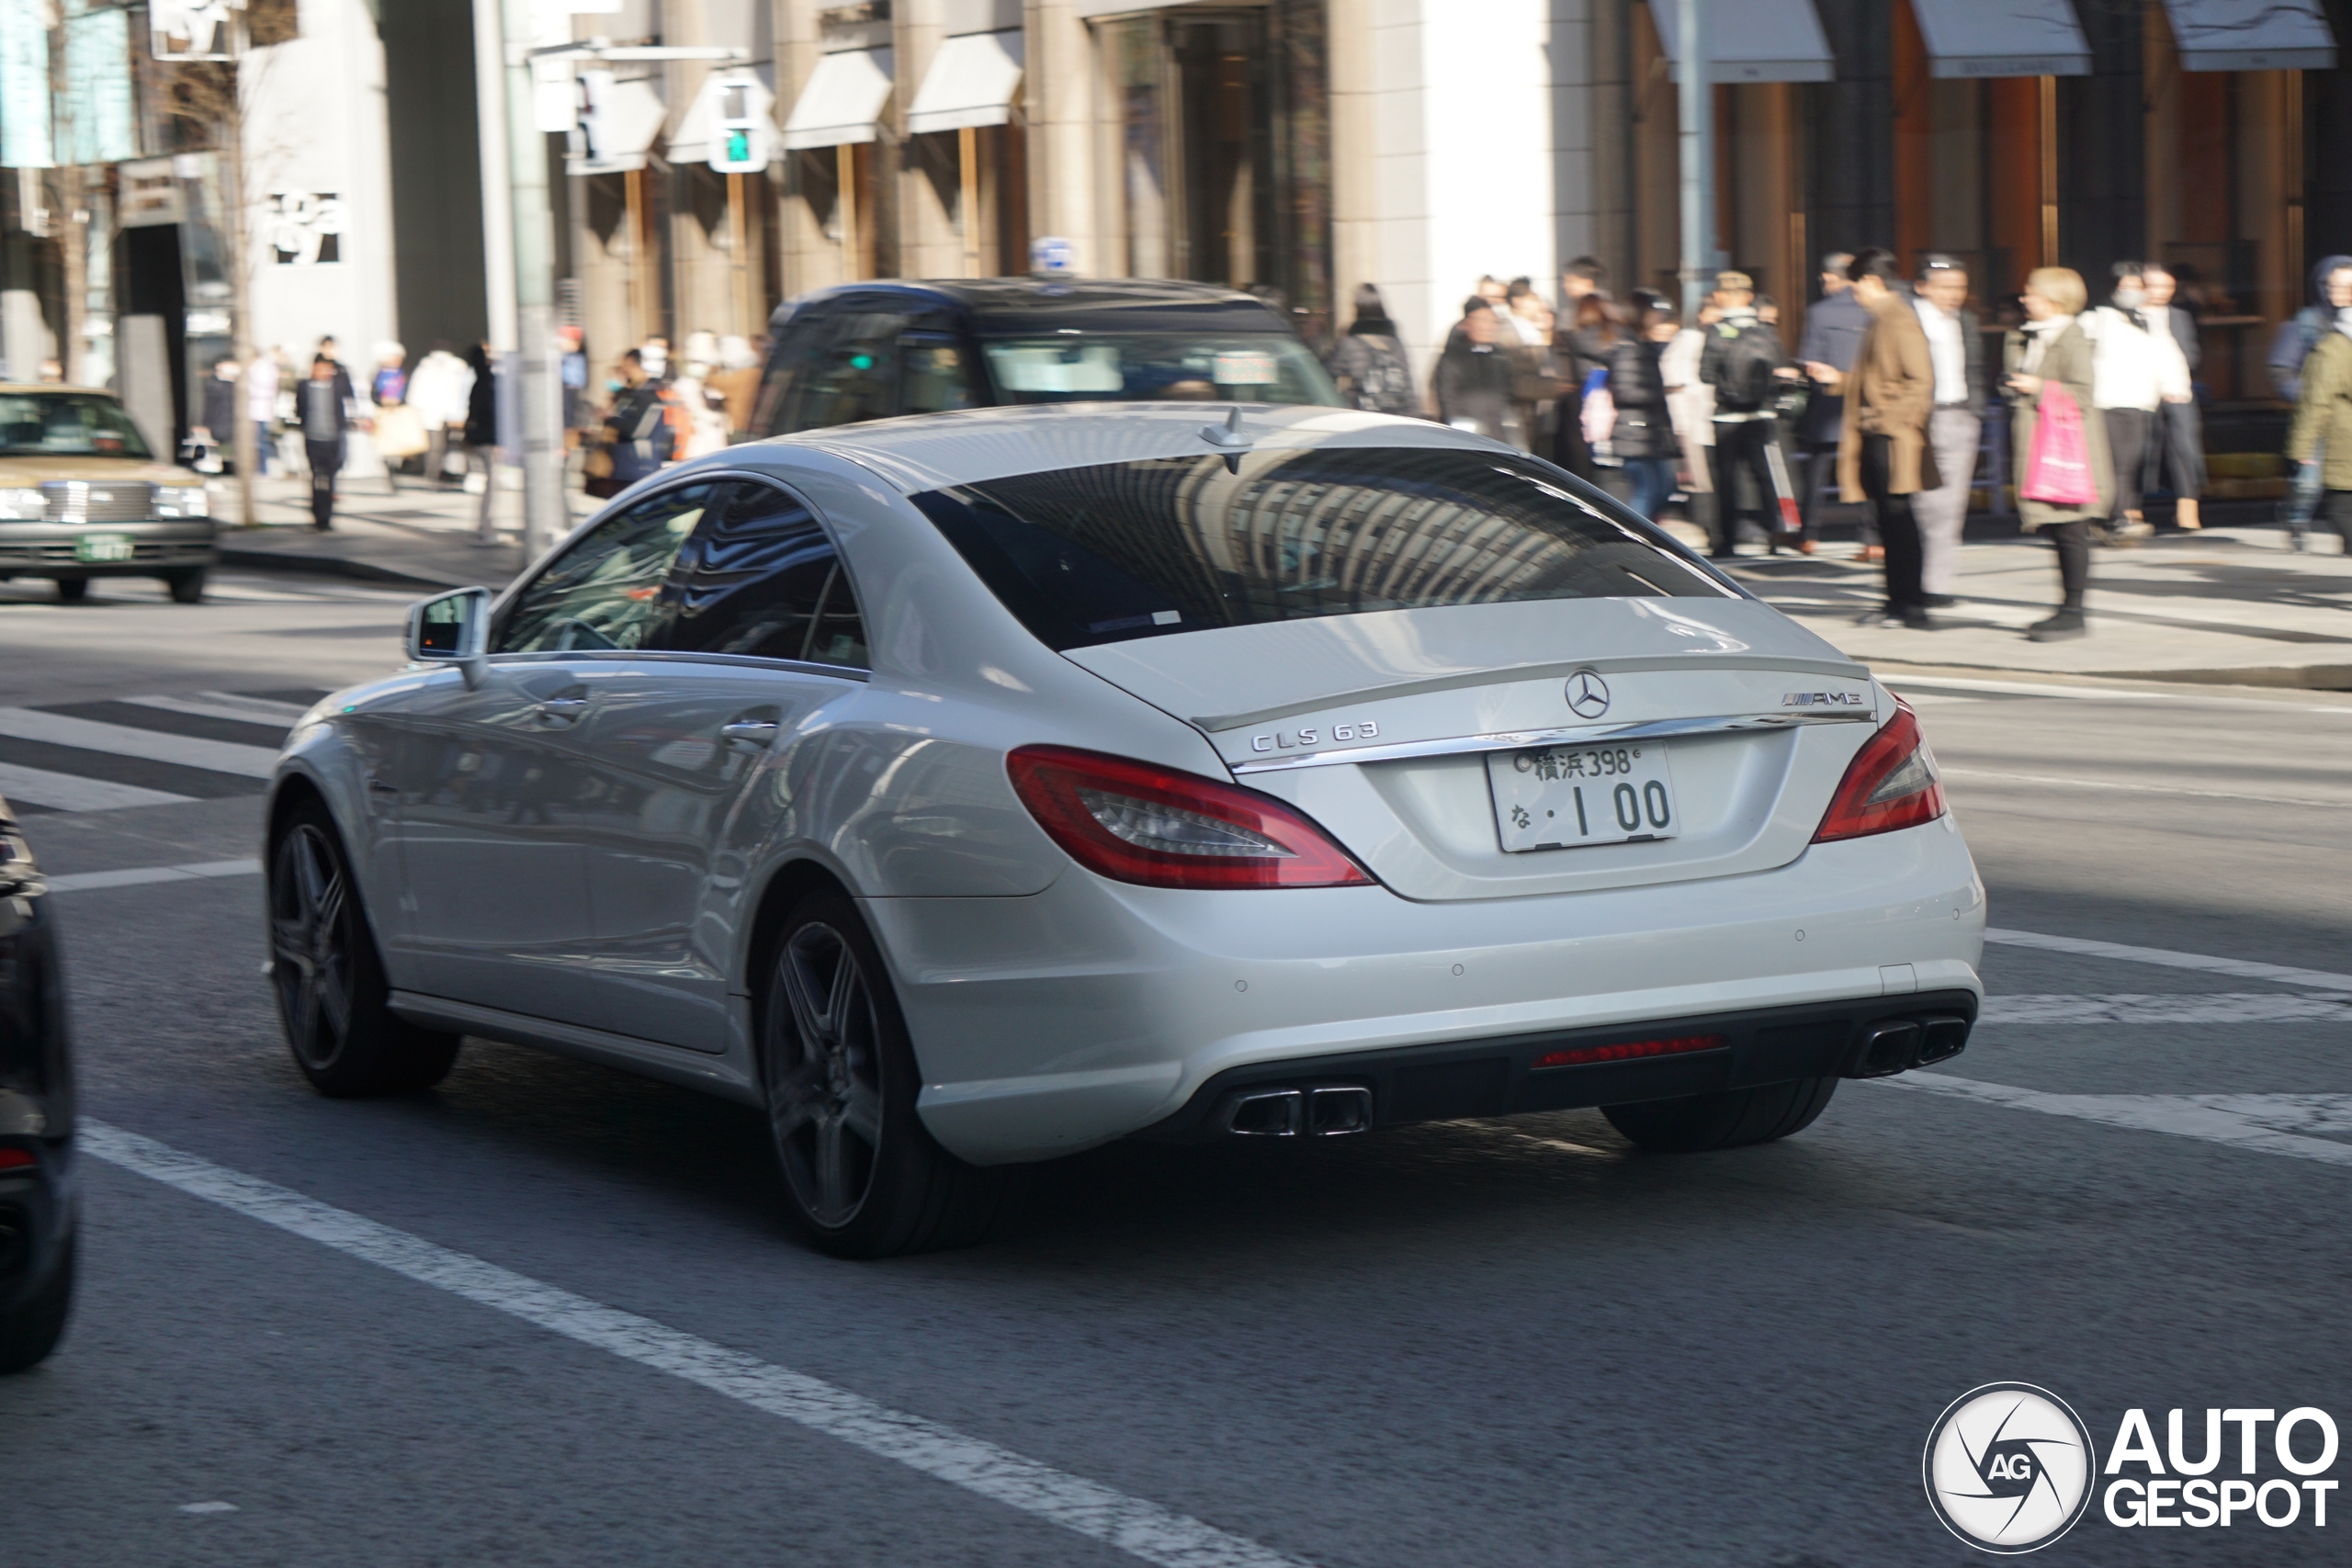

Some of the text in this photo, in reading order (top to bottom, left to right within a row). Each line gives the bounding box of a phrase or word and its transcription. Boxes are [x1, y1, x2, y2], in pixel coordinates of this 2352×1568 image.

[1251, 720, 1379, 751] CLS 63
[1511, 805, 1531, 829] な
